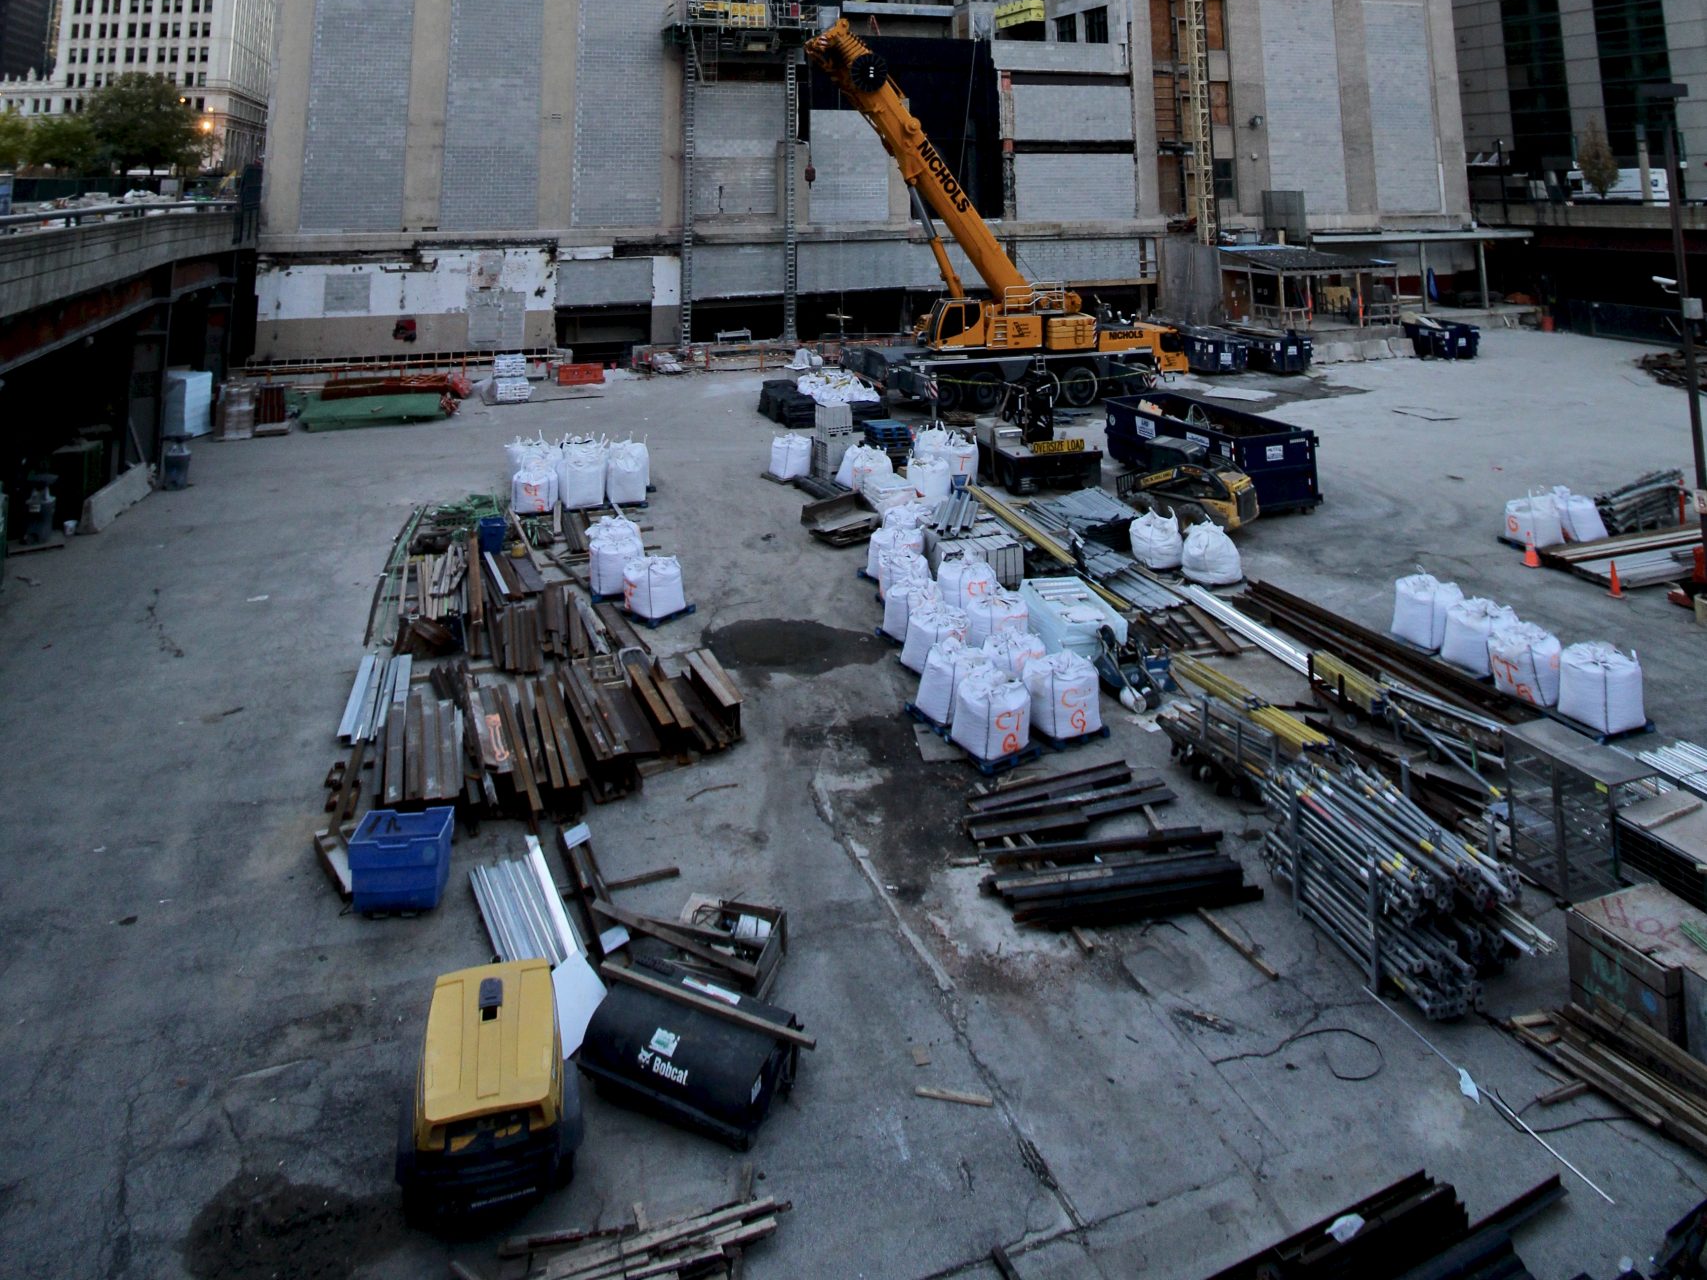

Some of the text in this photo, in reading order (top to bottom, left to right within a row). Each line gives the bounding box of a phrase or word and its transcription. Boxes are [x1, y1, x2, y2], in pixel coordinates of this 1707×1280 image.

[917, 140, 970, 213] NICHOLS
[1108, 330, 1144, 341] NICHOLS
[1034, 439, 1085, 453] OVERSIZE LOAD
[995, 711, 1024, 731] CT
[1070, 709, 1087, 733] G
[1002, 733, 1019, 753] G
[653, 1057, 688, 1086] Bobcat
